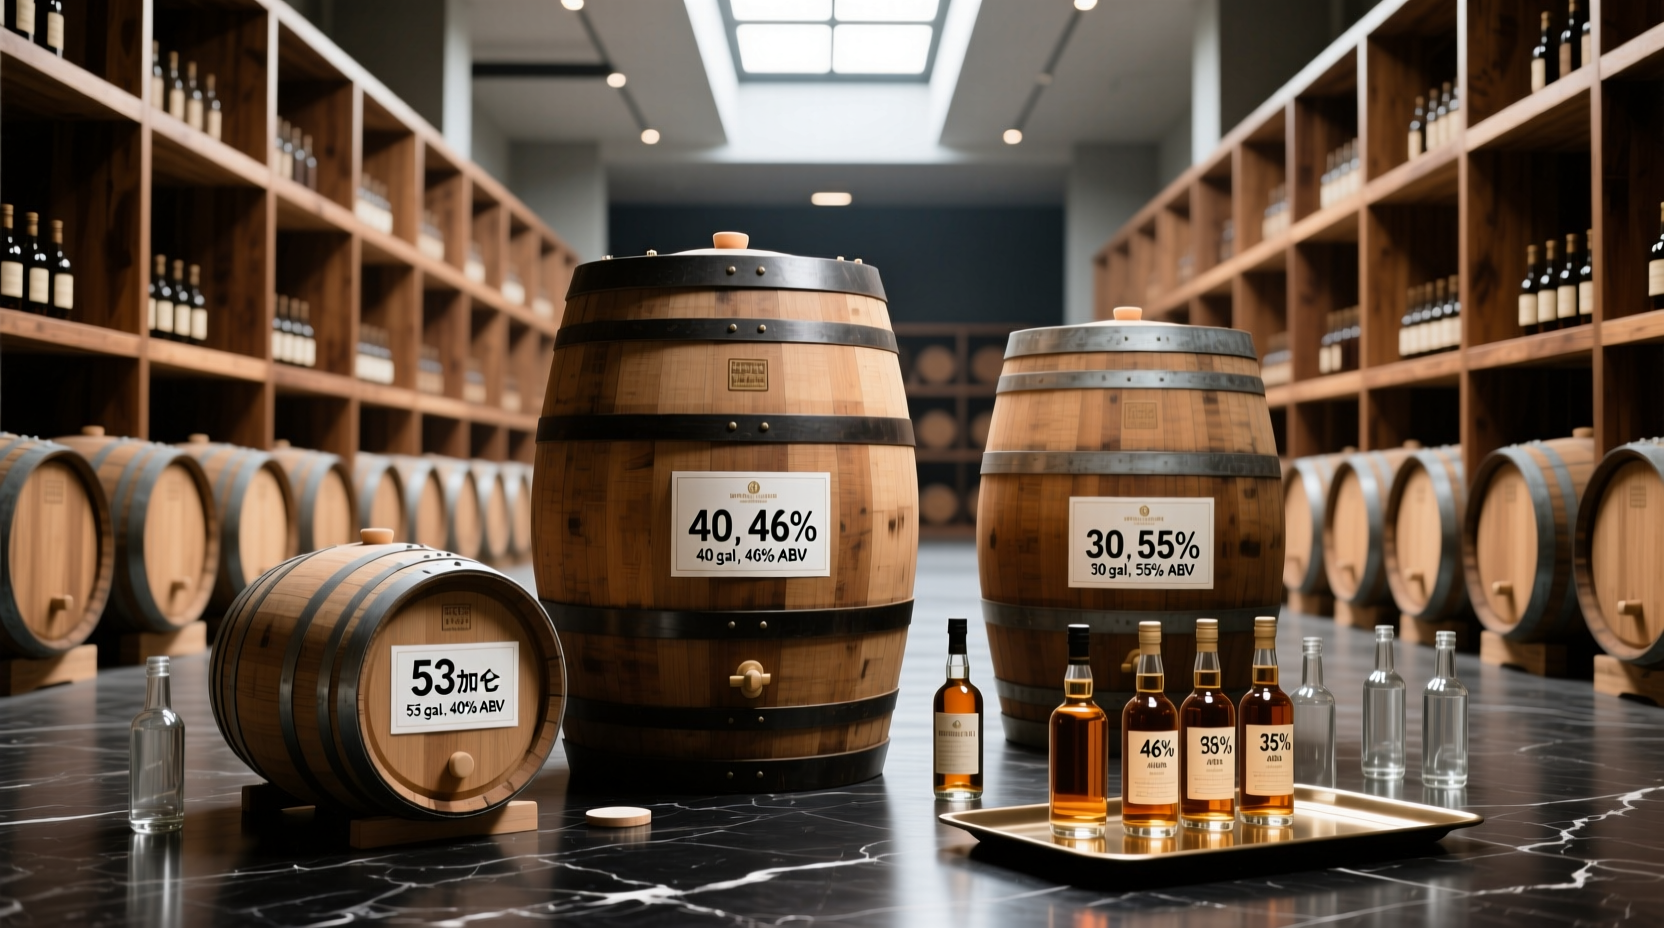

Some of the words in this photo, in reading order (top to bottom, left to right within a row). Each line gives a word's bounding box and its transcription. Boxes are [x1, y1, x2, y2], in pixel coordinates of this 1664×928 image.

[688, 509, 741, 546] 40,
[748, 509, 817, 542] 46%
[1085, 529, 1131, 562] 30,
[1137, 530, 1200, 559] 55%
[696, 548, 714, 562] 40
[716, 548, 741, 565] gal,
[745, 548, 775, 562] 46%
[777, 548, 808, 563] ABV
[1091, 563, 1106, 576] 30
[1108, 563, 1132, 579] gal,
[1168, 563, 1195, 577] ABV
[424, 703, 447, 720] gal,
[449, 700, 477, 715] 40%
[479, 699, 505, 713] ABV
[1139, 738, 1175, 758] 46%
[1259, 732, 1291, 752] 35%
